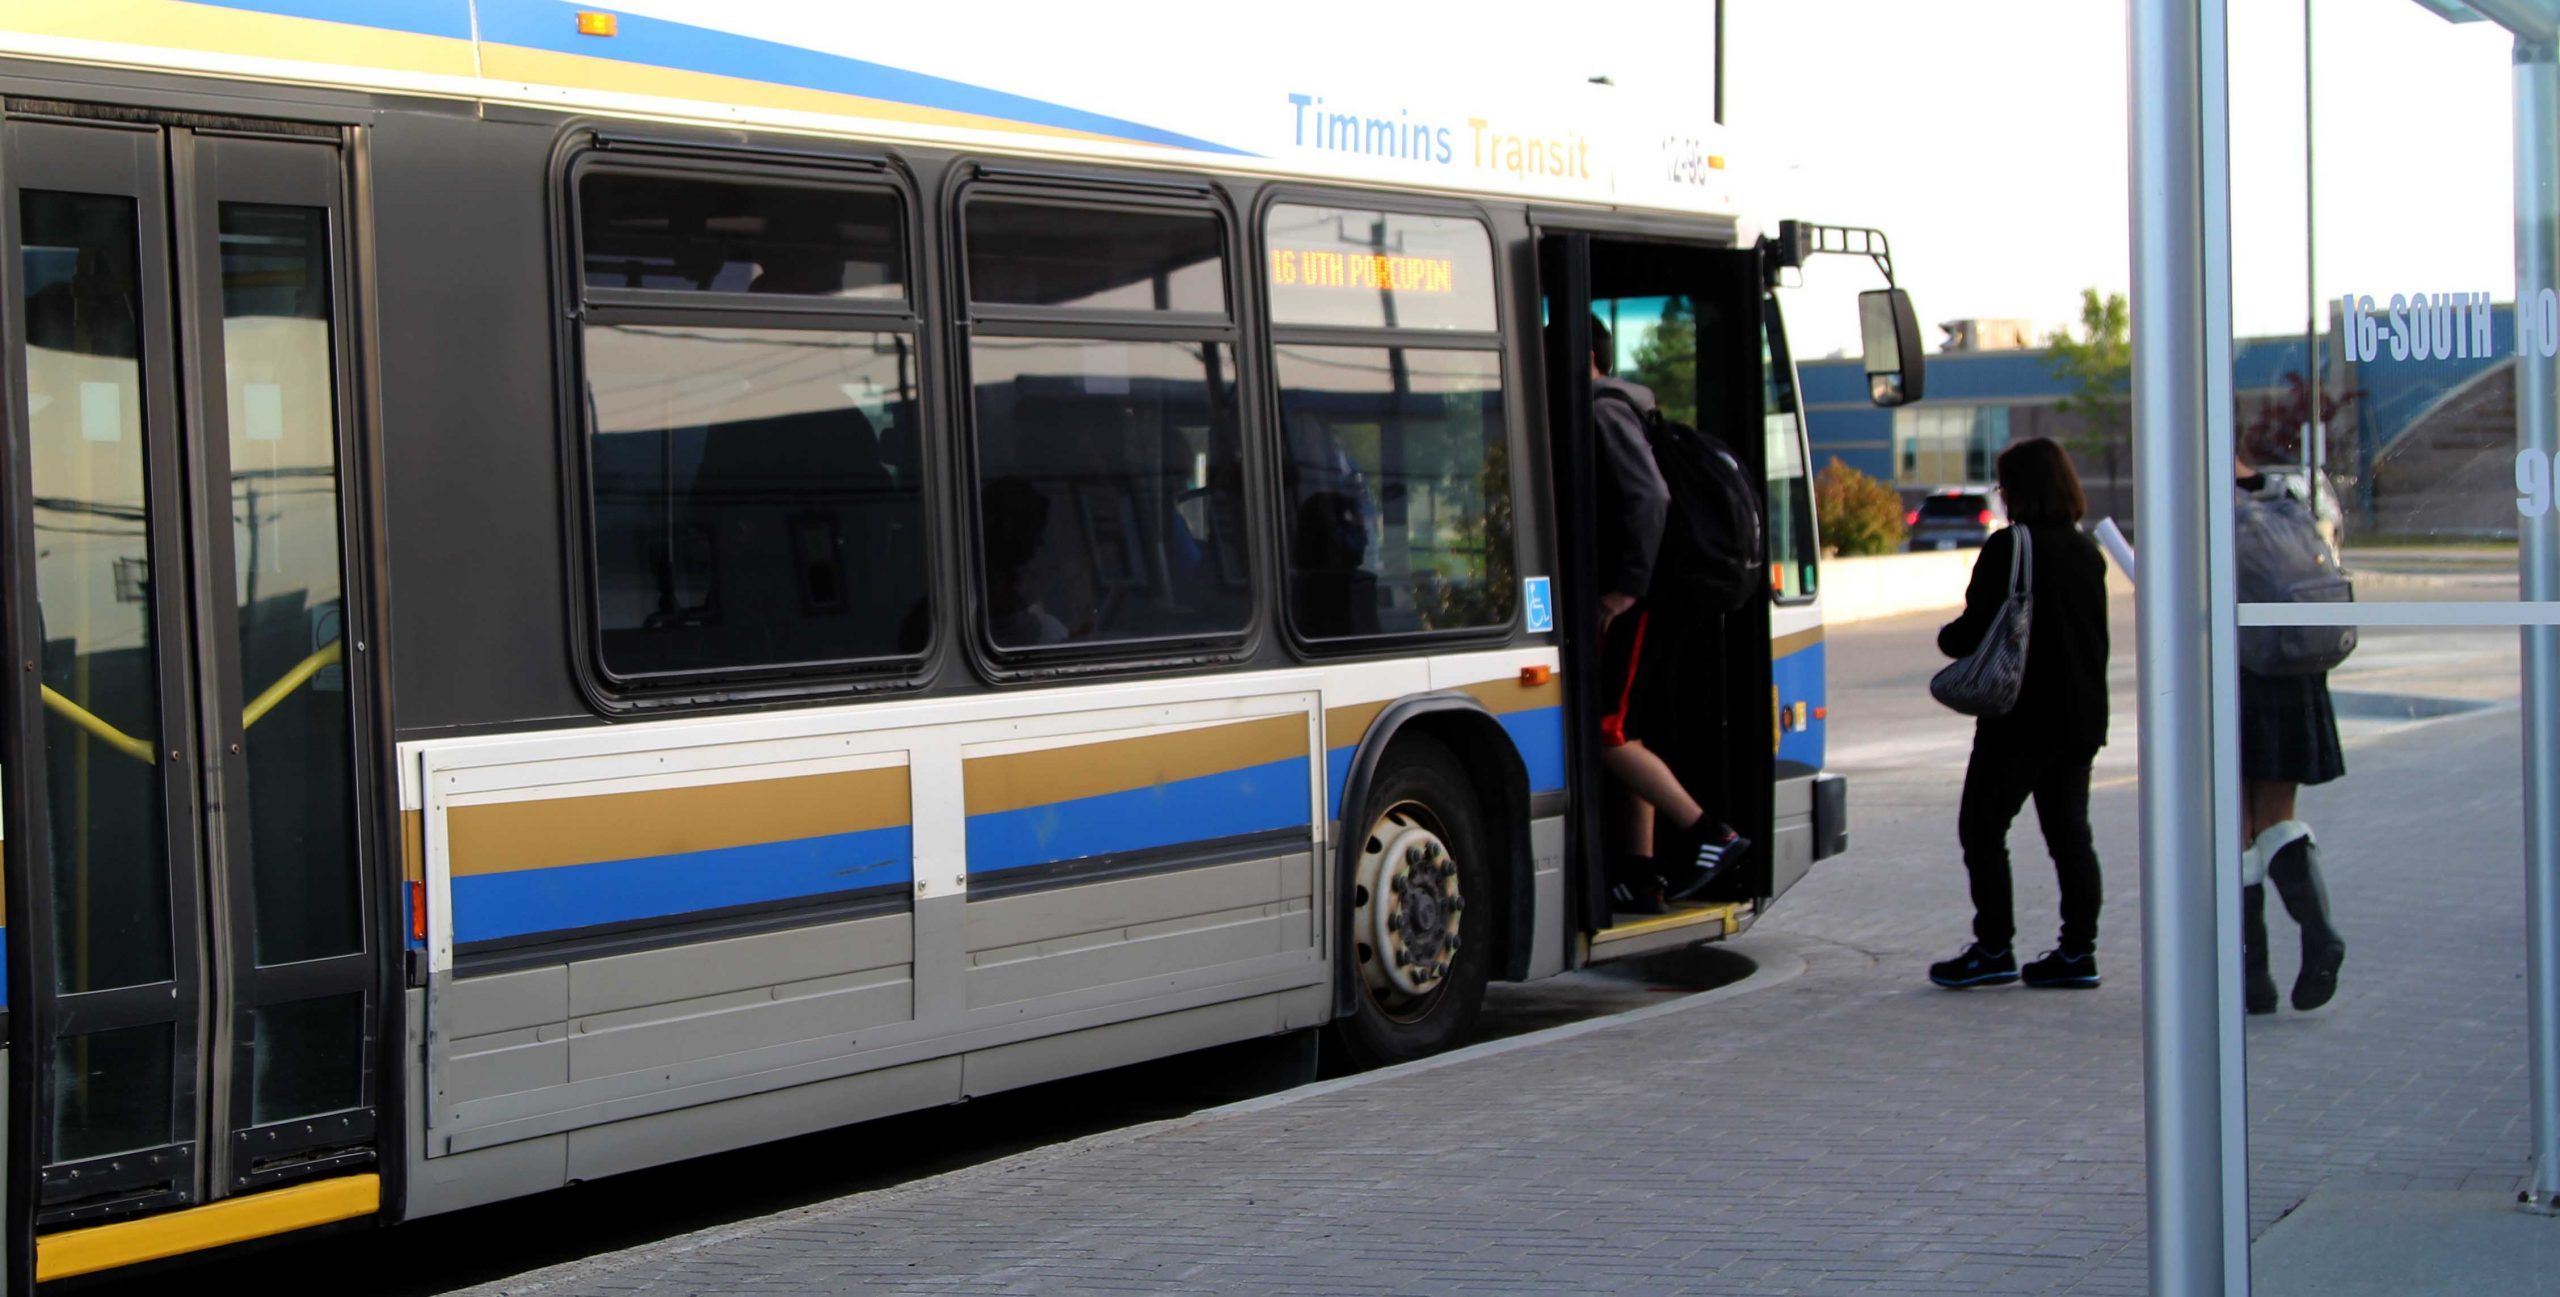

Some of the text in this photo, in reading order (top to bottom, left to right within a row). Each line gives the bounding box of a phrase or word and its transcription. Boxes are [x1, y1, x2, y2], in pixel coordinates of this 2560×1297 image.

[1288, 92, 1590, 181] Timmins Transit
[1272, 249, 1453, 292] 16 UTH PORCUPIN
[2342, 287, 2560, 362] 16-SOUTH PO
[2515, 447, 2560, 518] 9
